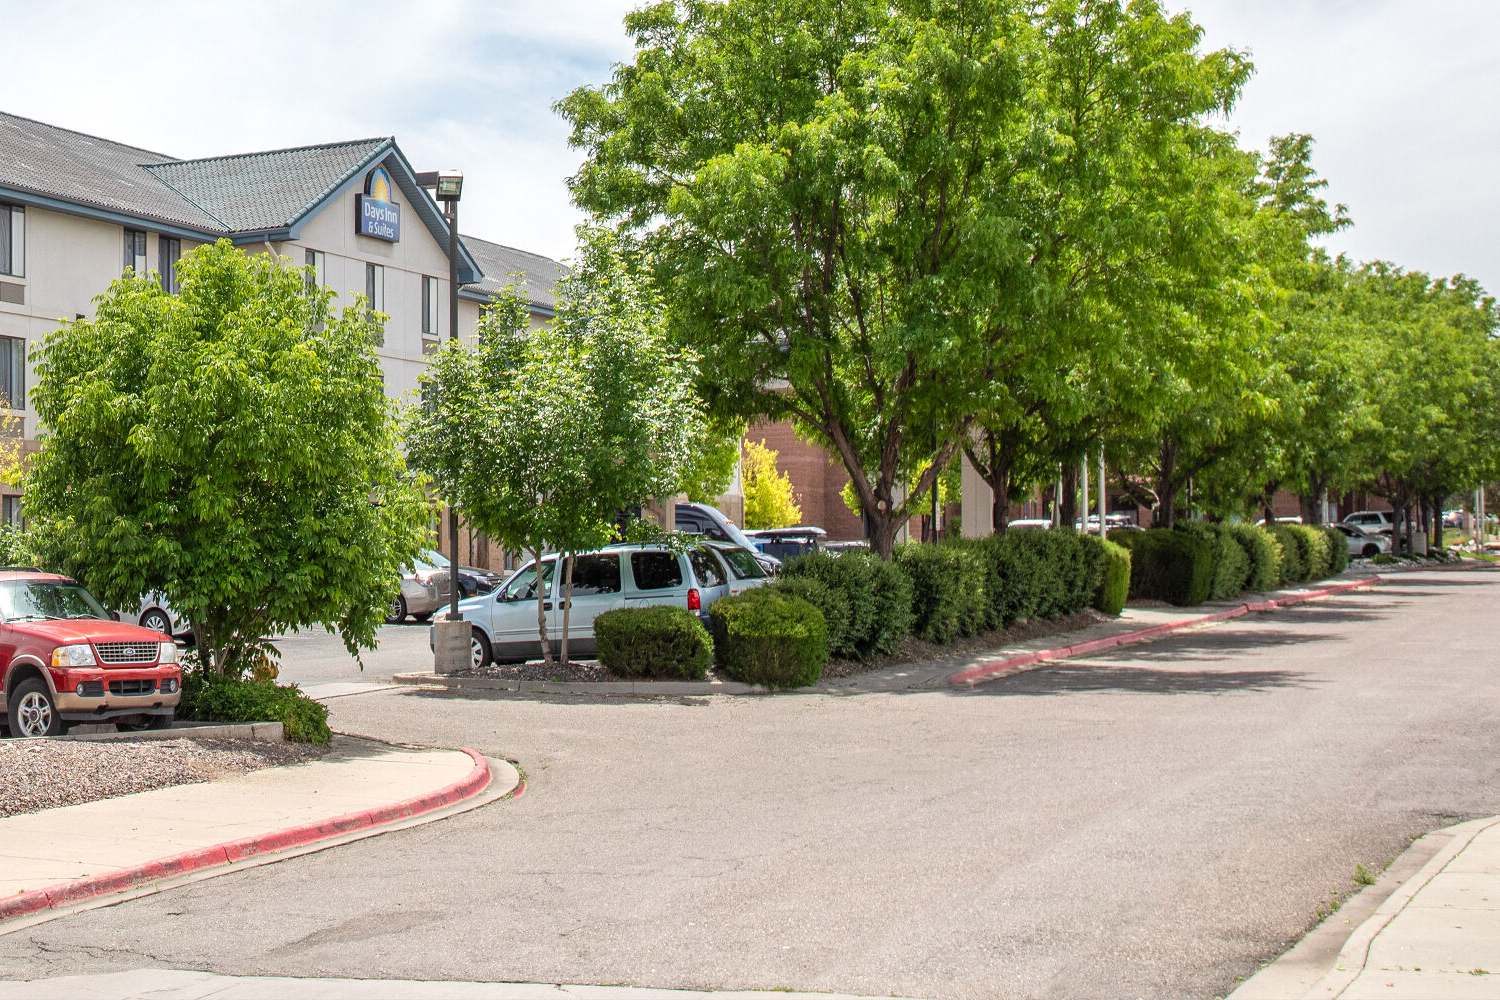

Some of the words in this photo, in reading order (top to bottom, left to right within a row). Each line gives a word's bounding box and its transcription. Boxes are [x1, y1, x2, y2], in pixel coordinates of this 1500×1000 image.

[364, 202, 384, 221] Days
[385, 207, 398, 224] Inn
[368, 221, 373, 233] &
[374, 222, 394, 238] Suites
